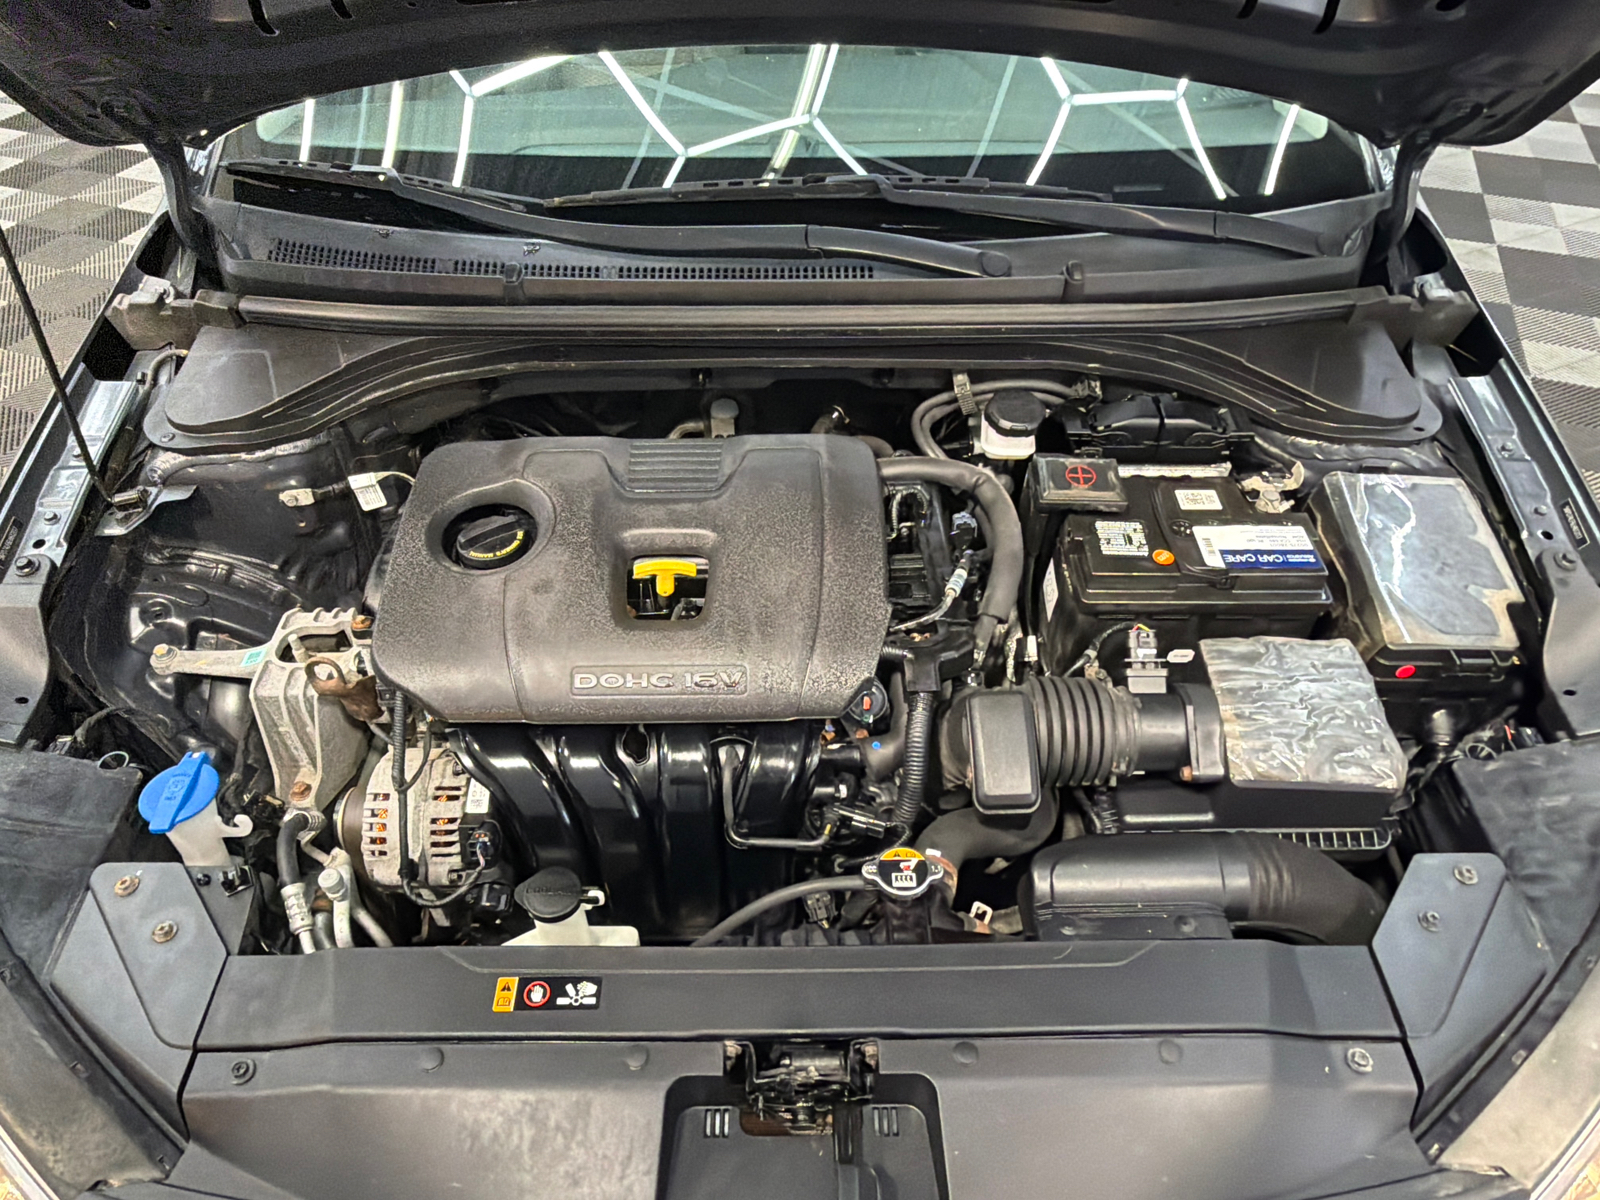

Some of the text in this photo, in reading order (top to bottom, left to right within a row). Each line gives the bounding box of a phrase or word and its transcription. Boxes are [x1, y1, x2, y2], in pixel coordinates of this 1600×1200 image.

[1223, 554, 1256, 563] CARE
[1257, 554, 1284, 563] CAR
[573, 671, 744, 690] DOHC 16V
